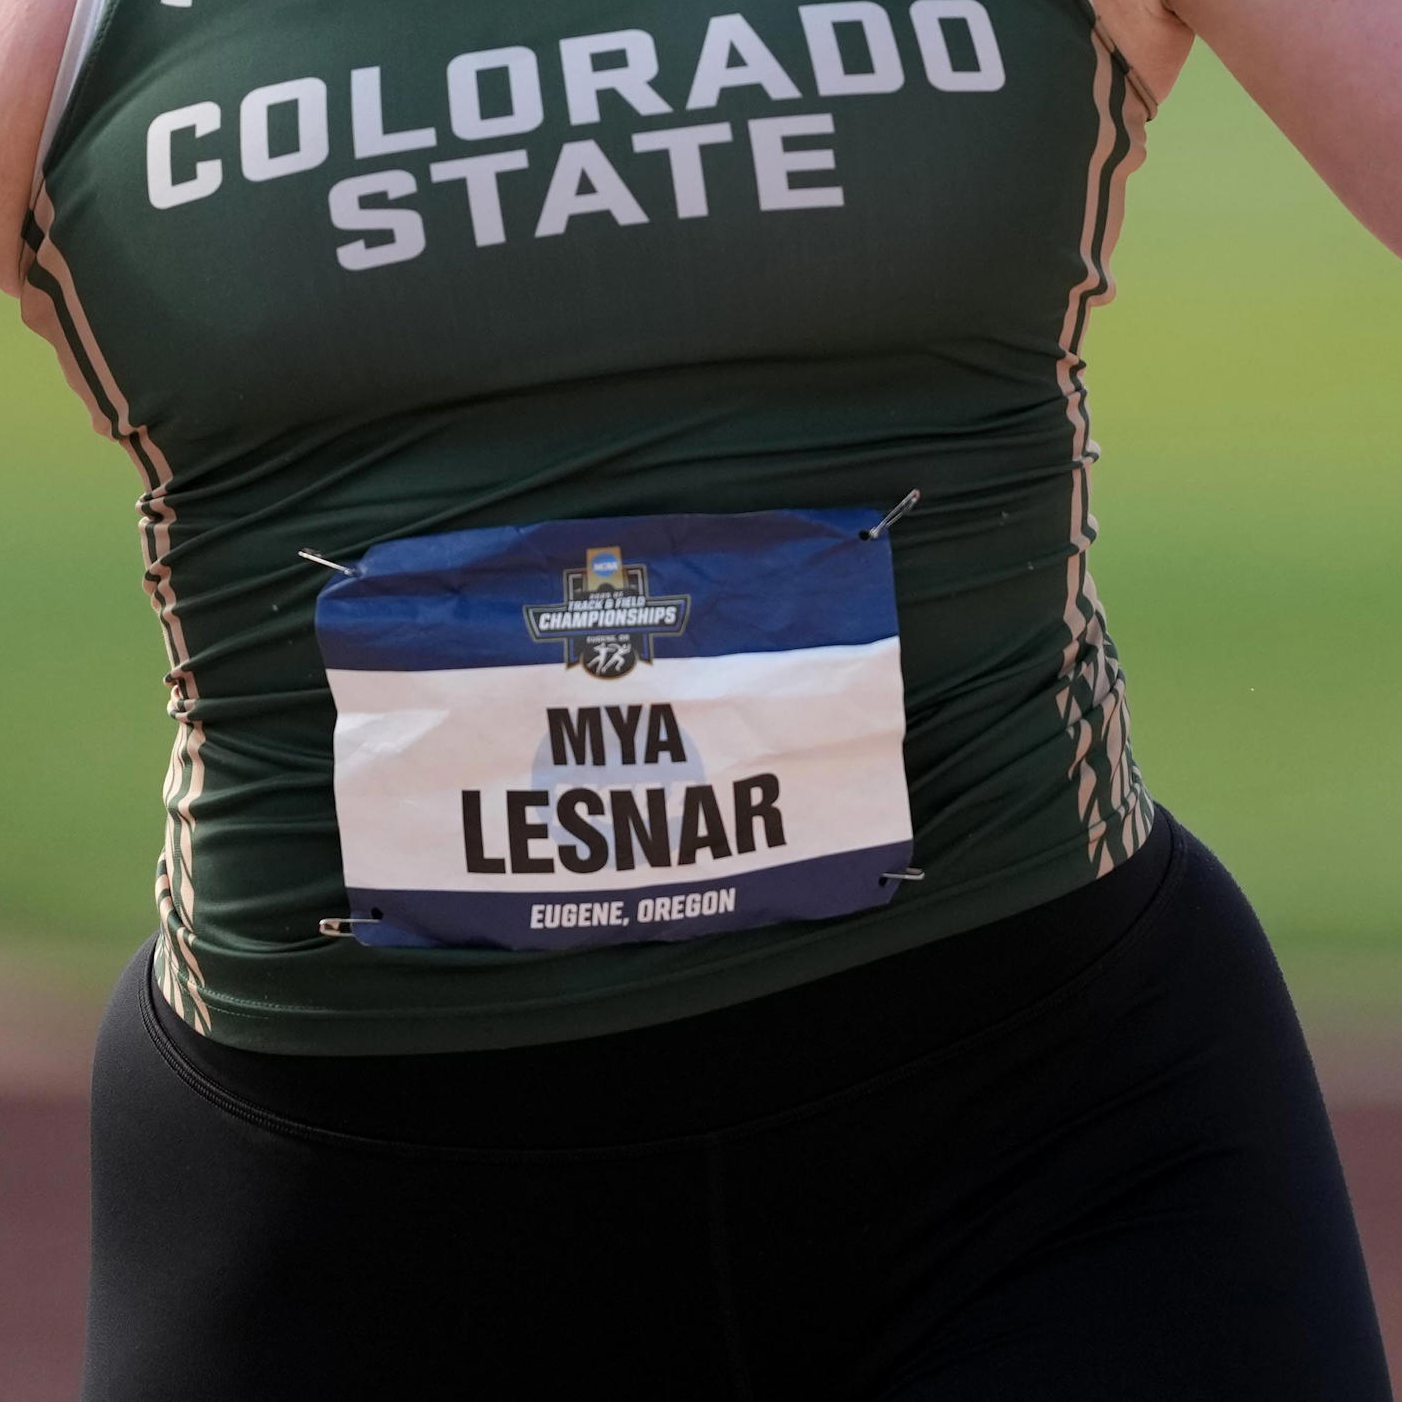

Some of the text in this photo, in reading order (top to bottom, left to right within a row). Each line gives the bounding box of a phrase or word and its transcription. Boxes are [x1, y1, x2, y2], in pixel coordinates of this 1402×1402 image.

[327, 112, 846, 272] STATE
[539, 606, 677, 630] CHAMPIONSHIPS
[568, 598, 604, 612] TRACK
[614, 596, 646, 609] FIELD
[546, 703, 687, 766] MYA
[461, 773, 788, 875] LESNAR
[529, 887, 736, 930] EUGENE, OREGON
